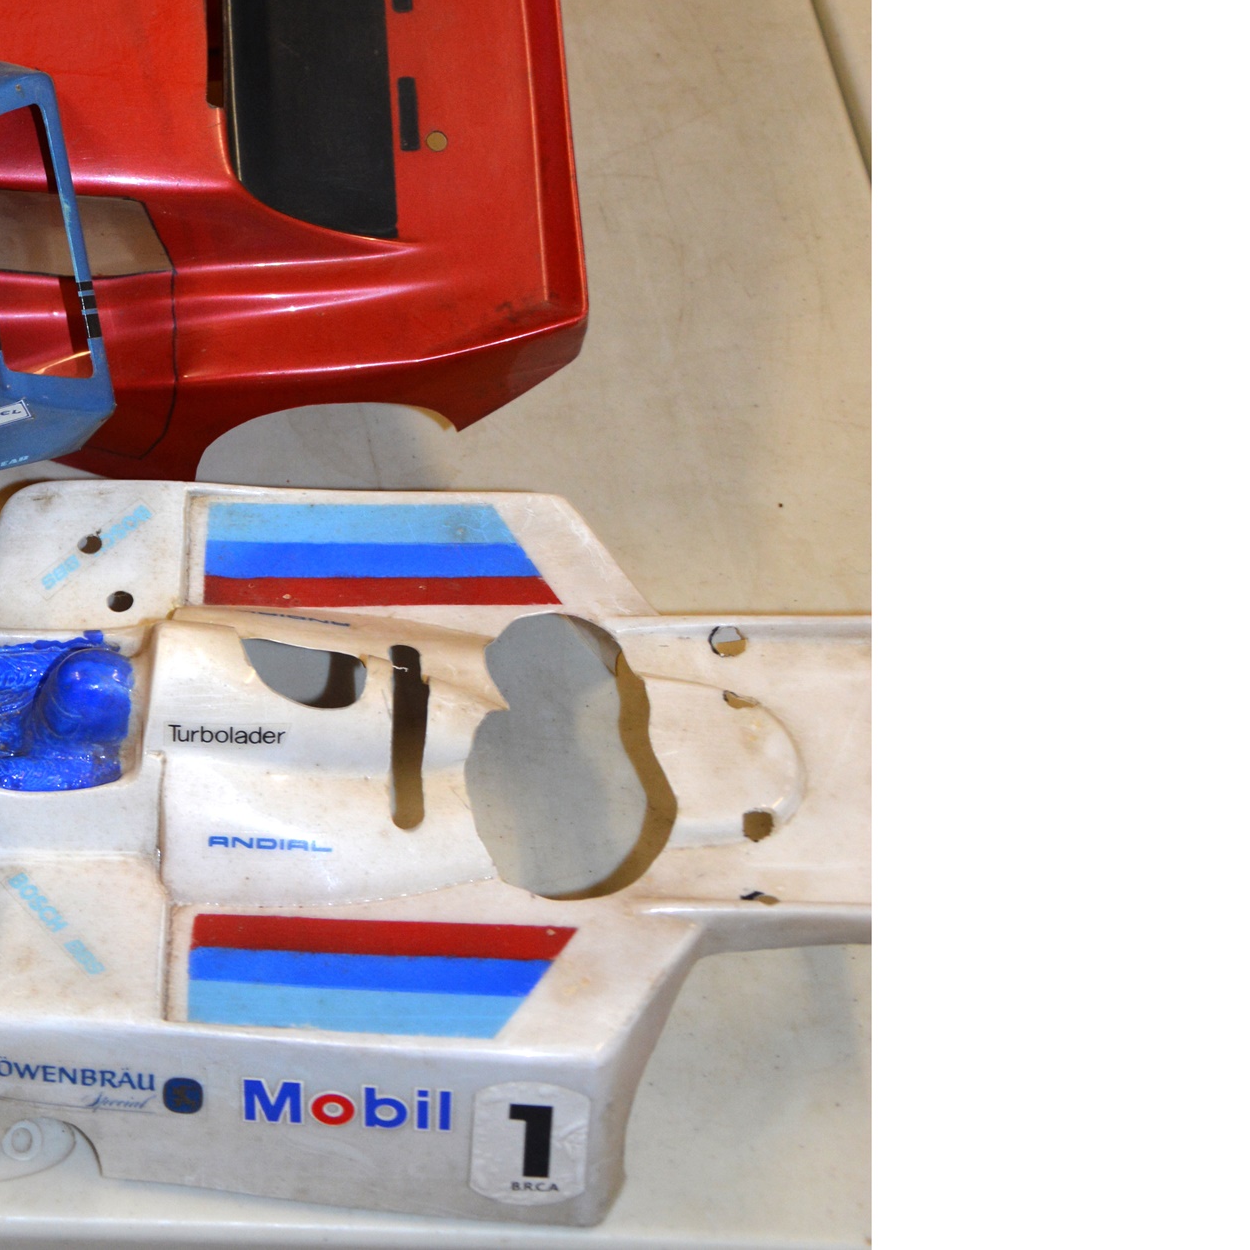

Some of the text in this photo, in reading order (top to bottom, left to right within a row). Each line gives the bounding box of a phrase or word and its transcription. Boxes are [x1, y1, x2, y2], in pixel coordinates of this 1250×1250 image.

[168, 724, 286, 744] Turbolader
[208, 835, 333, 853] ANDIAL
[8, 872, 69, 933] BOSCH
[242, 1078, 453, 1131] Mobil
[509, 1103, 554, 1178] 1
